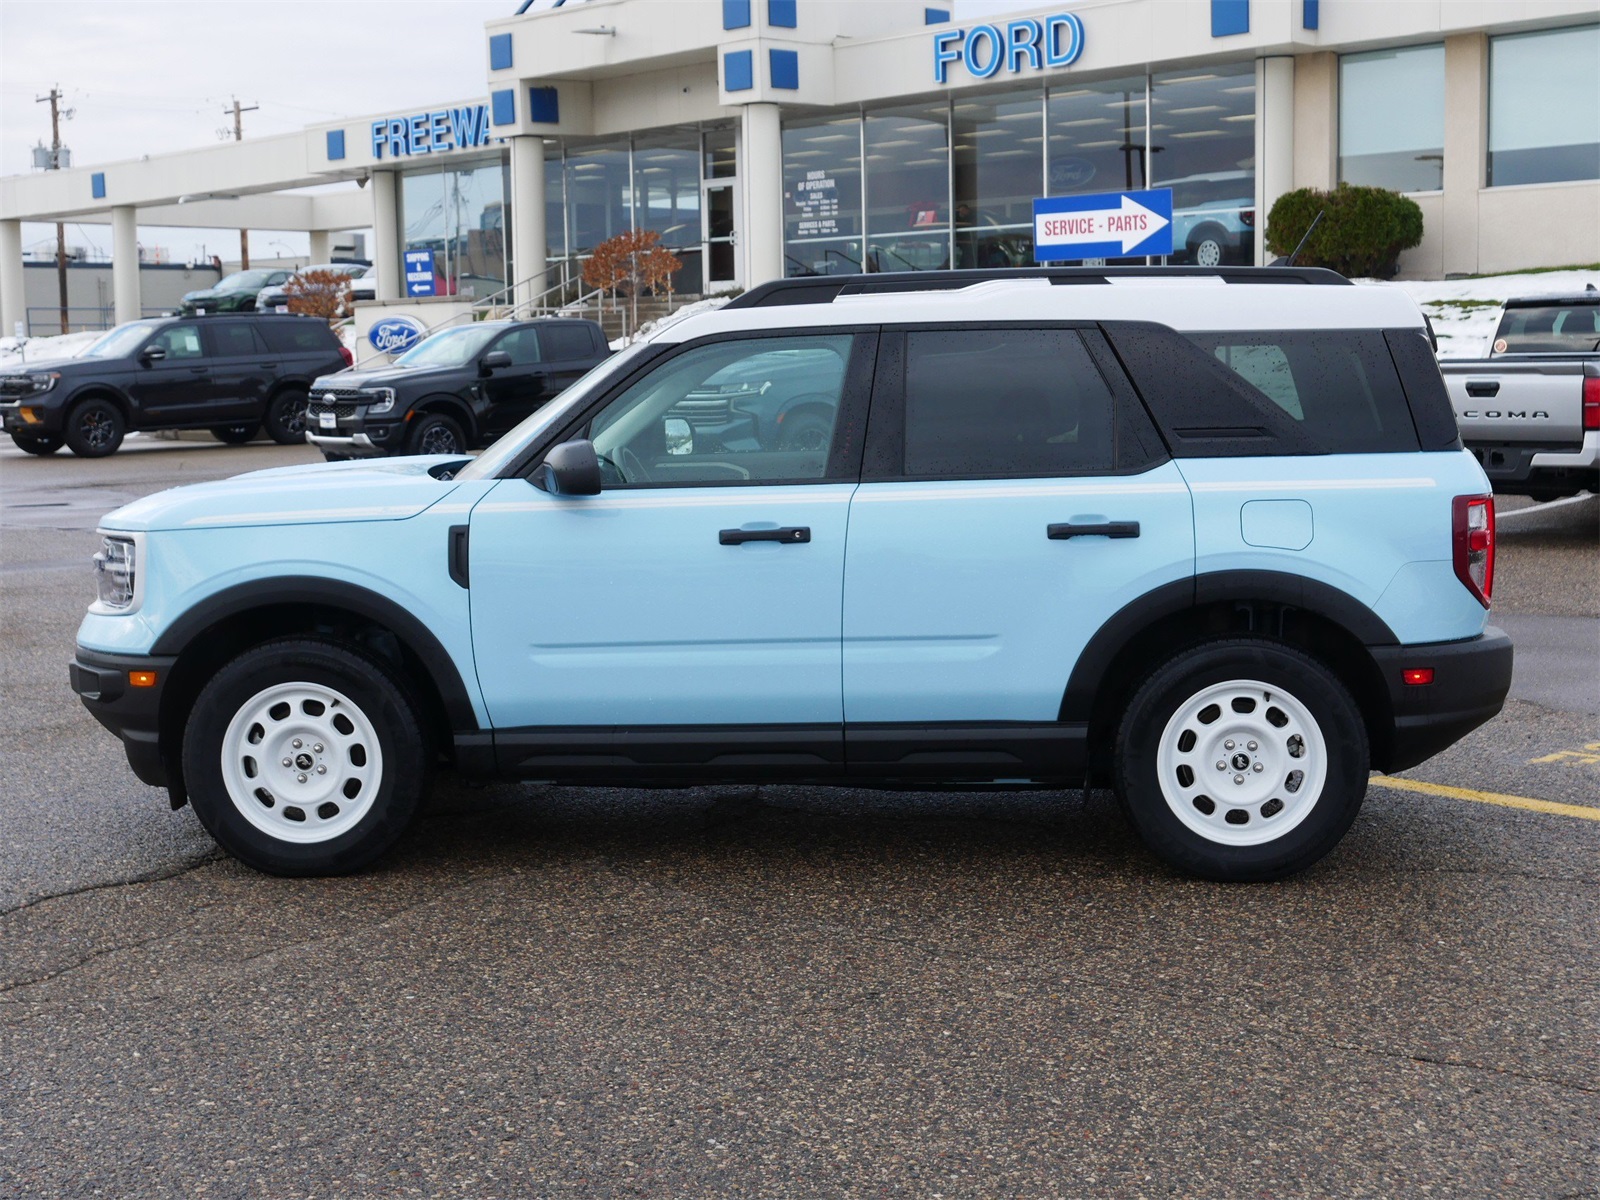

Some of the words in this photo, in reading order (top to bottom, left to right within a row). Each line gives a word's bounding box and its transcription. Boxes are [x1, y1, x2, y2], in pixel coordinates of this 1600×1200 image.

[934, 12, 1084, 83] FORD
[371, 105, 490, 159] FREEWA
[798, 181, 805, 191] OF
[806, 179, 835, 190] OPERATION
[1045, 218, 1094, 236] SERVICE
[1108, 214, 1147, 232] PARTS
[376, 324, 409, 348] Ford
[1455, 410, 1549, 418] COMA
